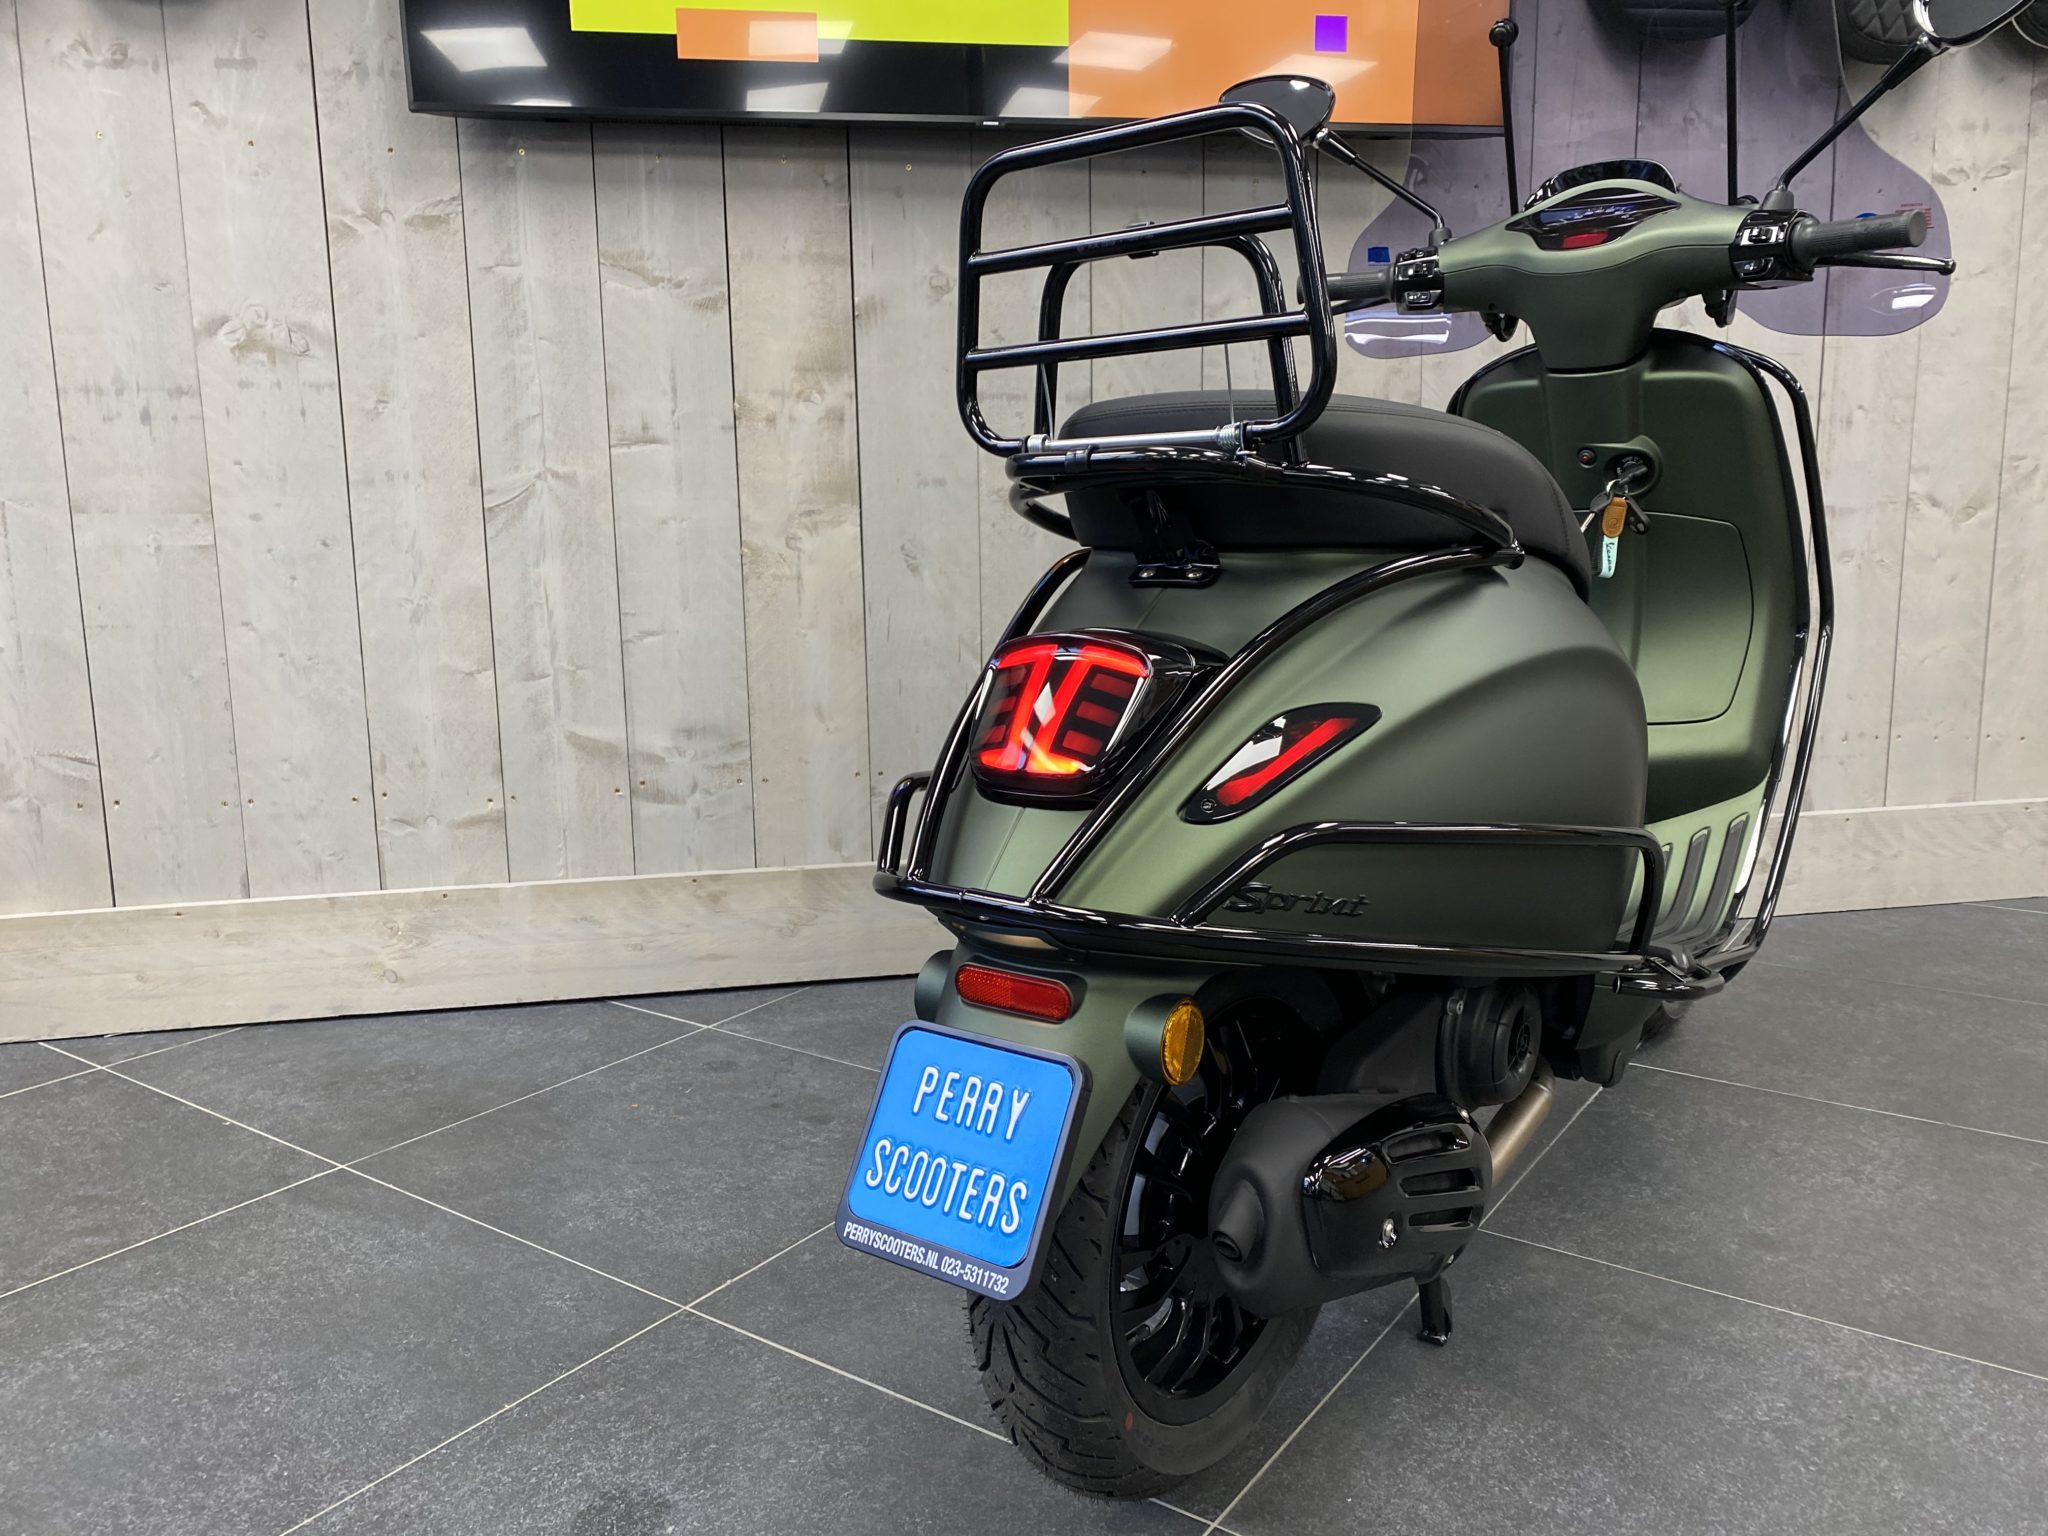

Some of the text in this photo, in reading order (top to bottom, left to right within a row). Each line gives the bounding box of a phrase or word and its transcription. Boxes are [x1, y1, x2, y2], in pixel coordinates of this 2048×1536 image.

[1222, 881, 1370, 916] Sprint
[912, 1066, 1030, 1140] PERRY
[866, 1139, 1028, 1234] SCOOTERS
[843, 1221, 1010, 1294] PERRYSCOOTERS.NL 023-5311732
